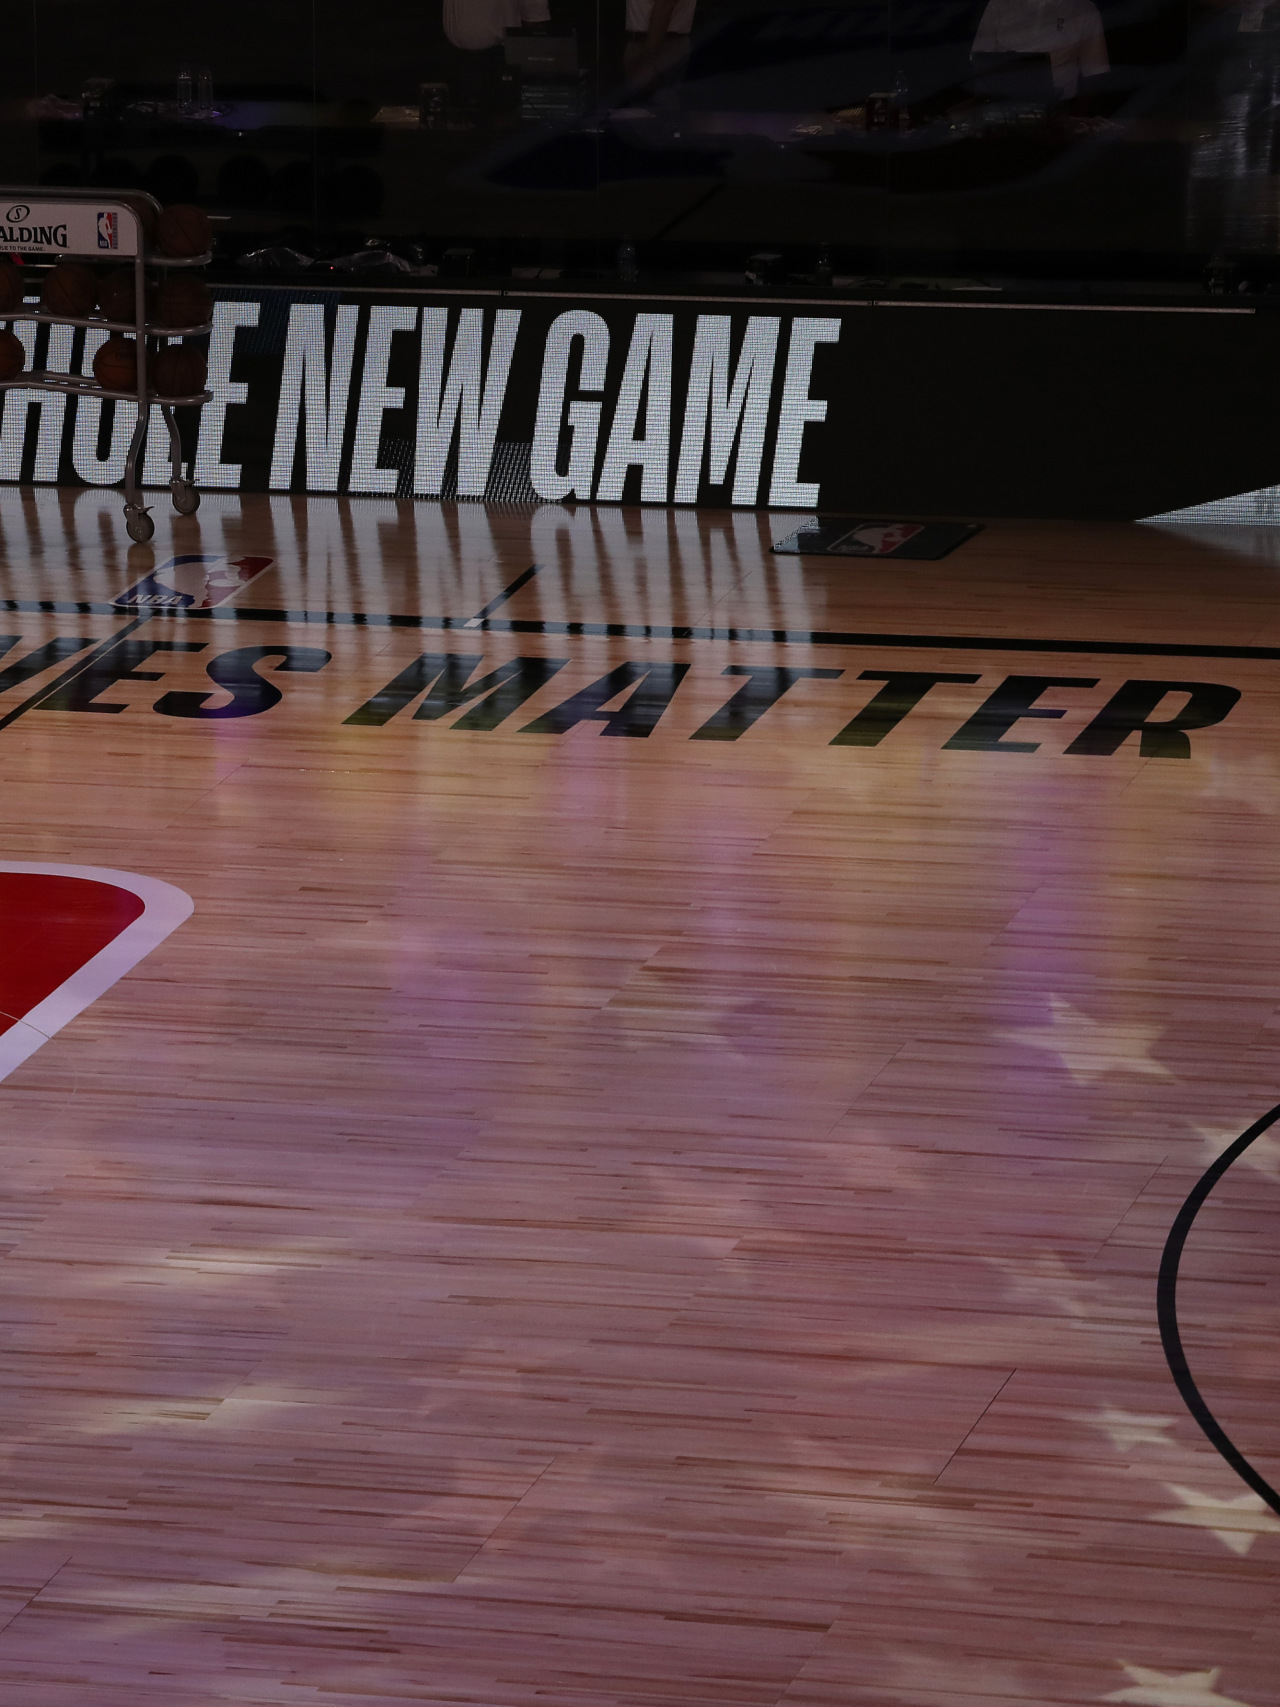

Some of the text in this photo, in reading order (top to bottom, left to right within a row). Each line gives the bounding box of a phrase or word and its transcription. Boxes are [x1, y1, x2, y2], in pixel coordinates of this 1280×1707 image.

[269, 303, 522, 498] NEW
[529, 309, 841, 508] GAME
[127, 595, 182, 605] NBA
[341, 652, 1241, 759] MATTER
